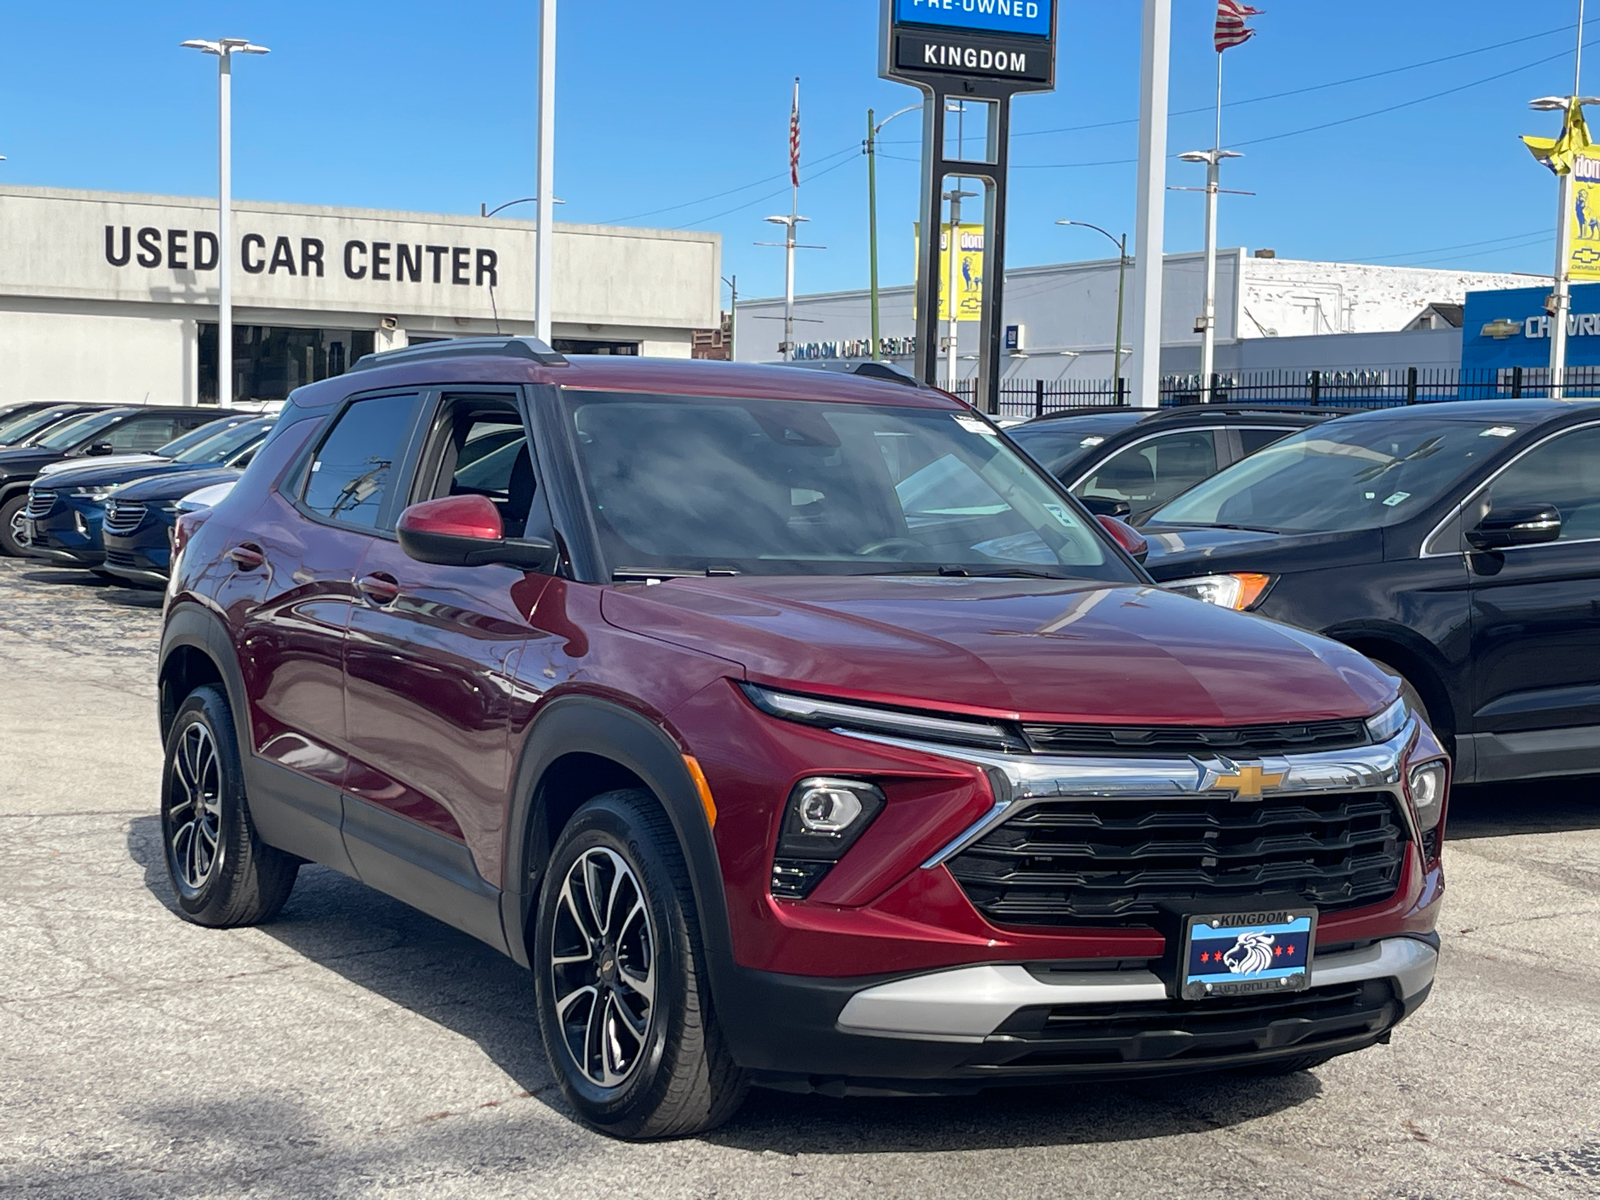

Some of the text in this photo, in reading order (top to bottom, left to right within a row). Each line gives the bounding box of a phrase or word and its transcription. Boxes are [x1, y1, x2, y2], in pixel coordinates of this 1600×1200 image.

[924, 44, 1026, 72] KINGDOM
[104, 224, 499, 287] USED CAR CENTER
[1524, 314, 1600, 338] CHVR
[1220, 911, 1288, 926] KINGDOM
